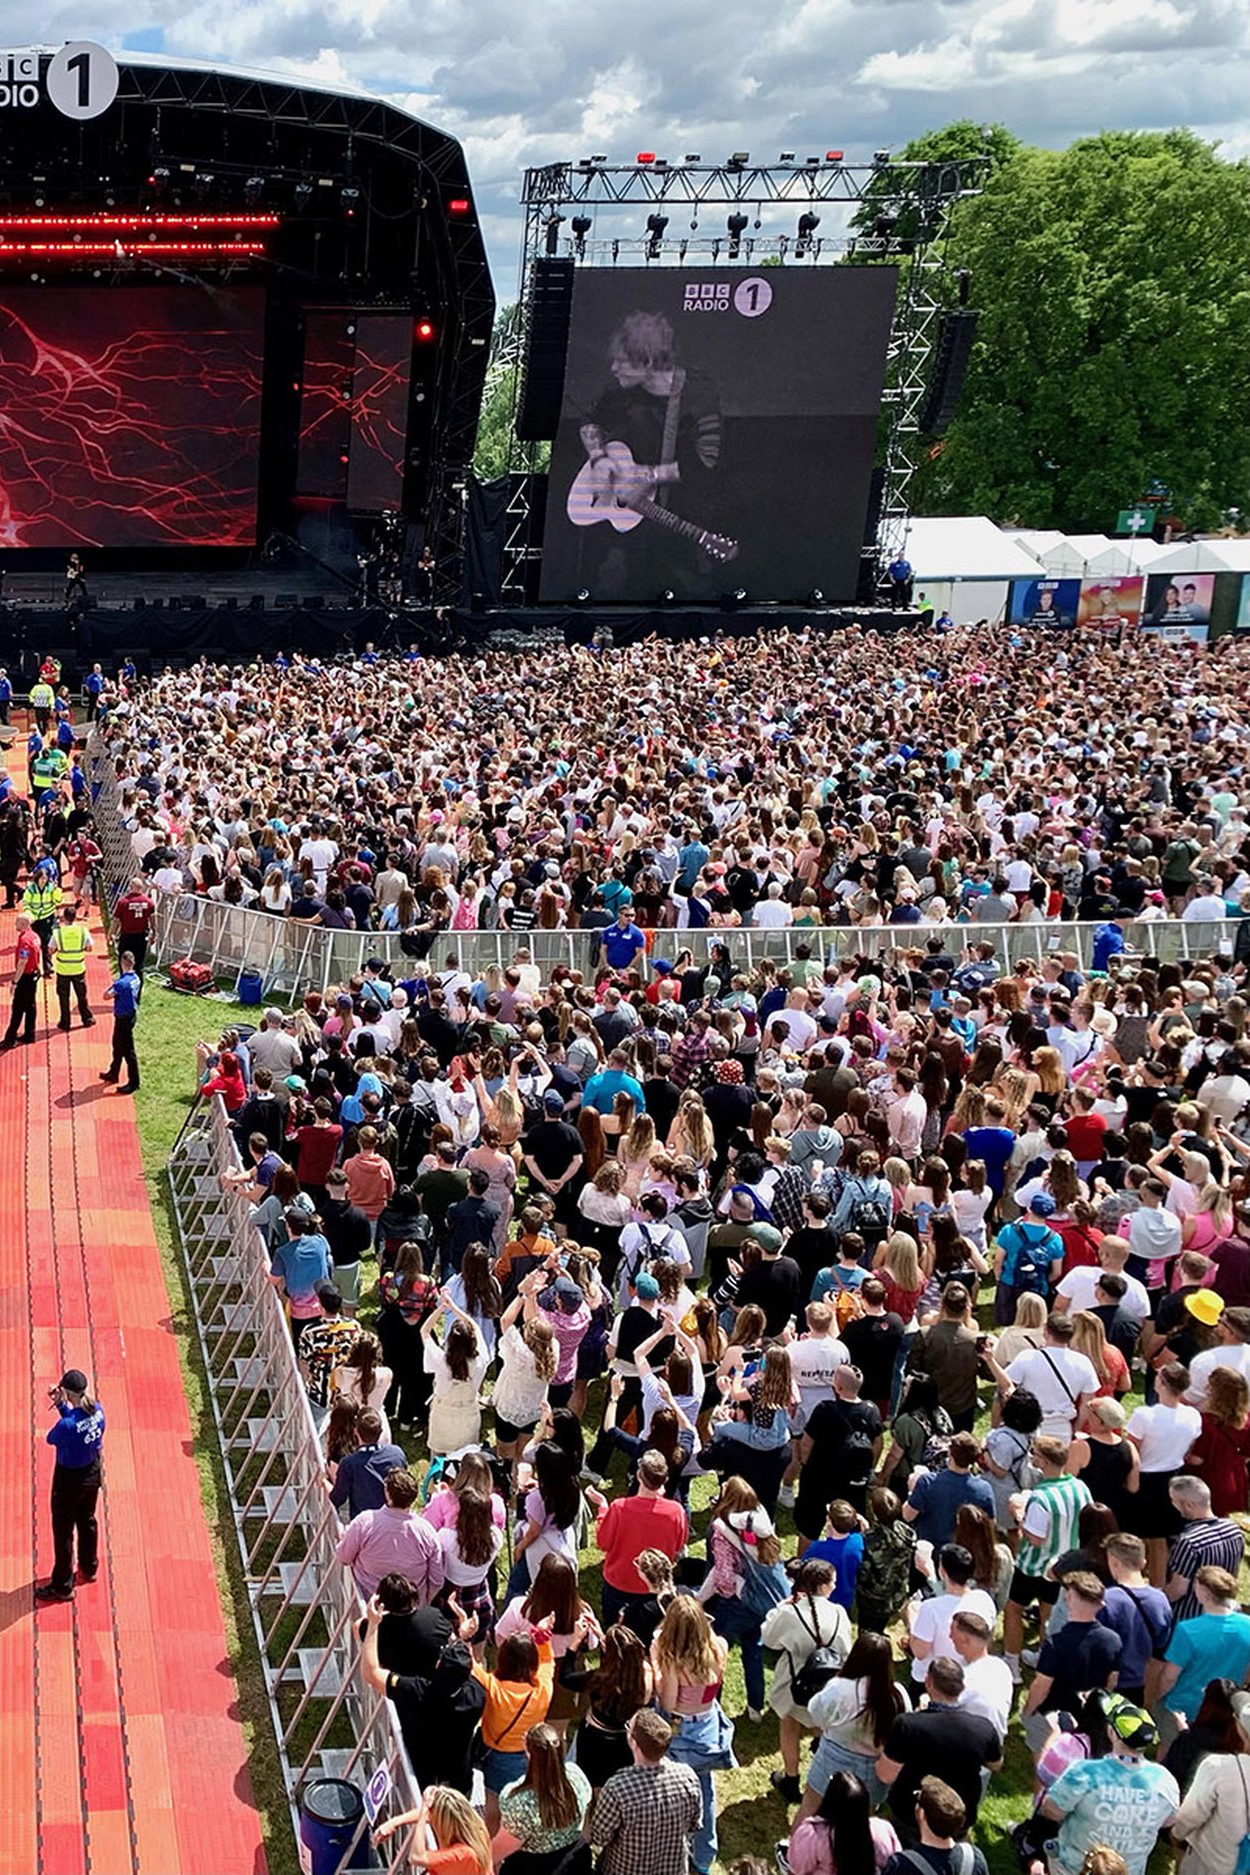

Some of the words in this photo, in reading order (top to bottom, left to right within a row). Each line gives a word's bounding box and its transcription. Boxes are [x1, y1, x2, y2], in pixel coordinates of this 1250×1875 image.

[67, 53, 90, 107] 1
[685, 284, 730, 298] BBC
[683, 299, 729, 311] RADIO
[1101, 1785, 1146, 1804] HAVE
[1094, 1801, 1160, 1826] COKE
[1097, 1823, 1132, 1838] AND
